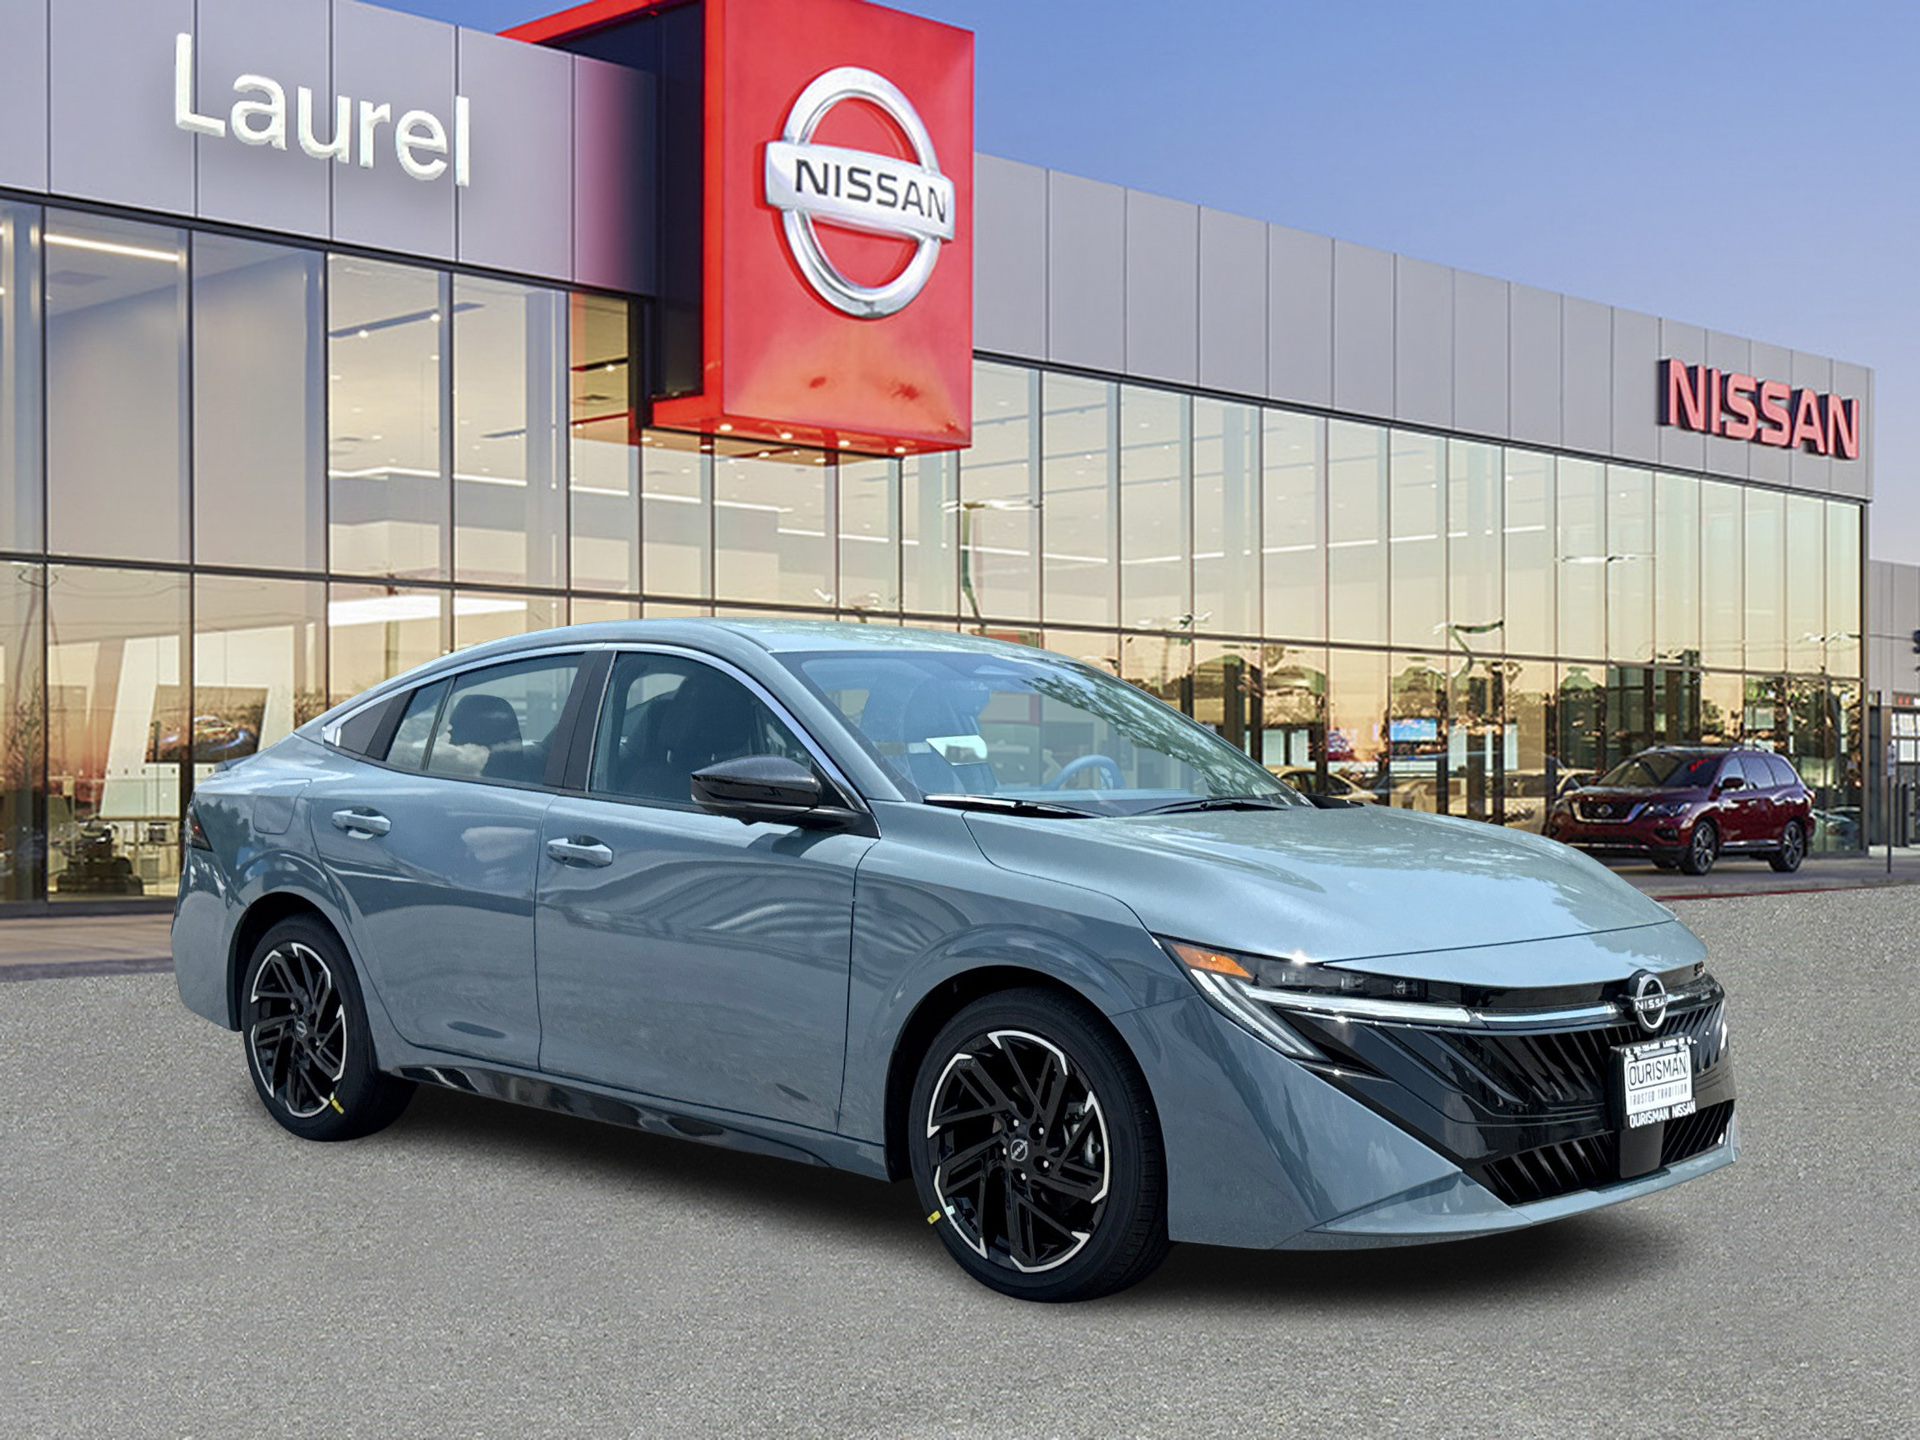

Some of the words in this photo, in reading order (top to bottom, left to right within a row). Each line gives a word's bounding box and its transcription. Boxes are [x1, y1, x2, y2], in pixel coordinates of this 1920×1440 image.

[174, 33, 470, 188] Laurel
[795, 158, 947, 224] NISSAN
[1665, 358, 1860, 460] NISSAN
[1629, 1056, 1687, 1086] OURISMAN
[1629, 1106, 1670, 1129] OURISMAN
[1671, 1097, 1696, 1119] NISSAN
